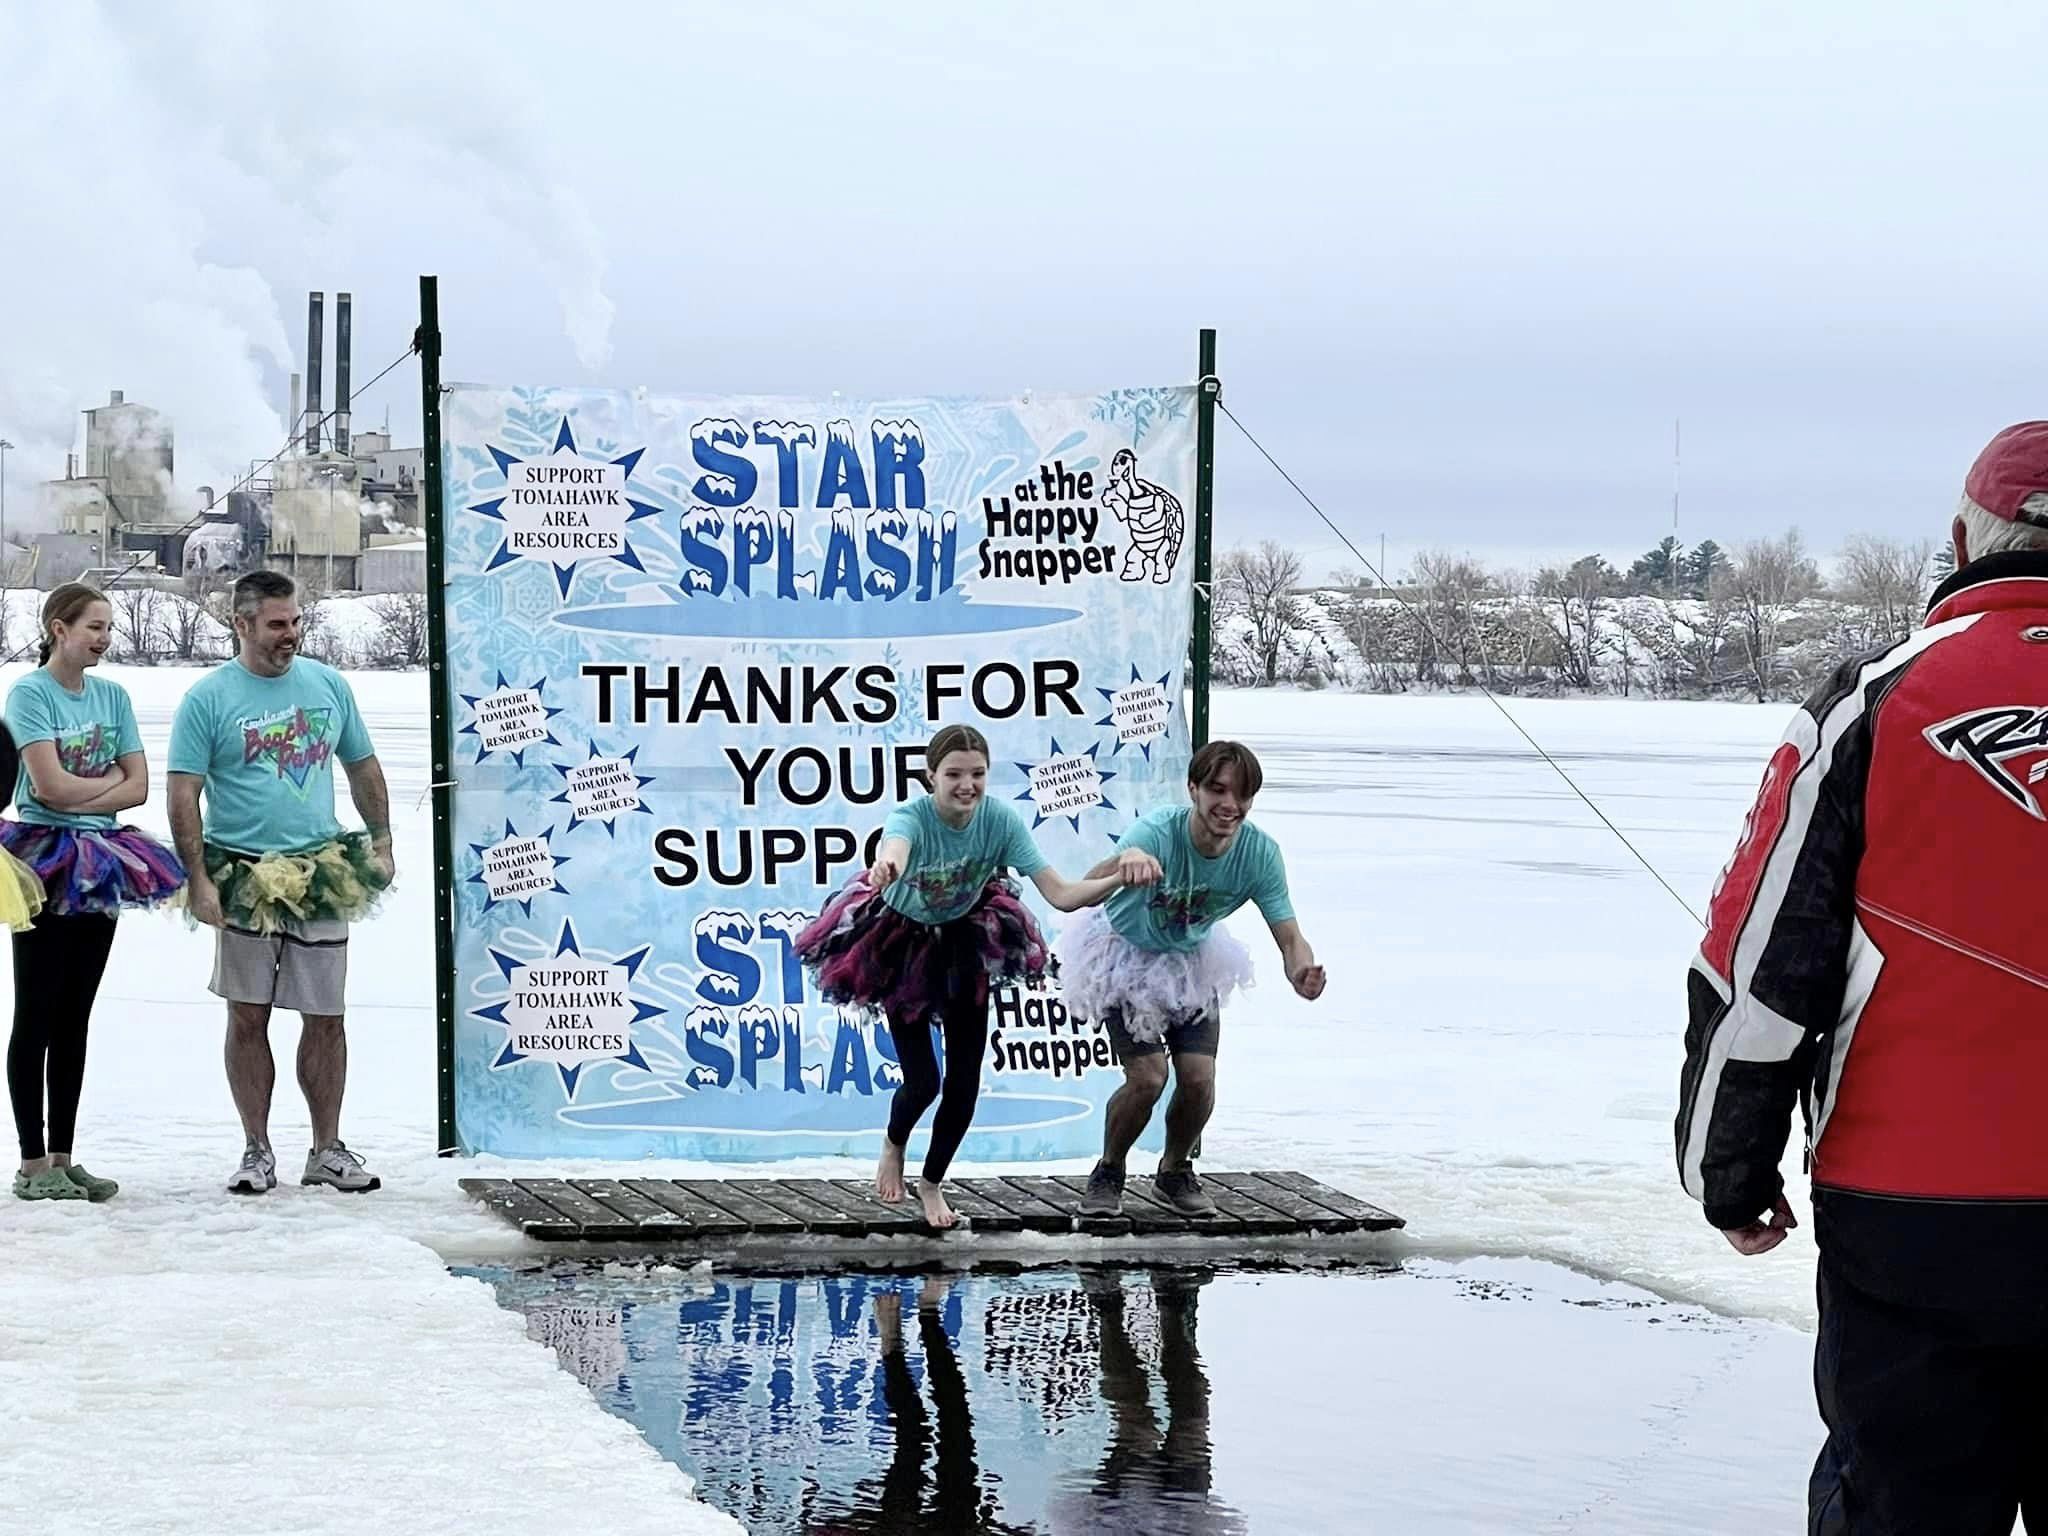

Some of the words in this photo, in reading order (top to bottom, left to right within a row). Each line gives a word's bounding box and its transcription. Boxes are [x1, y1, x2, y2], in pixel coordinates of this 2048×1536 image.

[689, 418, 926, 508] STAR
[526, 467, 605, 484] SUPPORT
[1015, 481, 1039, 502] at
[1040, 460, 1093, 501] the
[512, 489, 620, 506] TOMAHAWK
[541, 511, 589, 527] AREA
[982, 497, 1098, 544] Happy
[513, 532, 618, 549] RESOURCES
[679, 506, 957, 602] SPLASH
[979, 538, 1116, 586] Snapper
[484, 693, 529, 710] SUPPORT
[582, 665, 897, 725] THANKS
[926, 659, 1085, 721] FOR
[1120, 687, 1156, 703] SUPPORT
[480, 703, 540, 724] TOMAHAWK
[1116, 697, 1165, 716] TOMAHAWK
[499, 718, 526, 733] AREA
[1132, 712, 1154, 725] AREA
[486, 727, 545, 748] RESOURCES
[1120, 721, 1166, 739] RESOURCES
[576, 762, 621, 779] SUPPORT
[724, 745, 934, 806] YOUR
[1038, 758, 1083, 778] SUPPORT
[571, 772, 631, 793] TOMAHAWK
[1034, 768, 1094, 791] TOMAHAWK
[590, 788, 617, 802] AREA
[1053, 784, 1081, 799] AREA
[577, 796, 636, 818] RESOURCES
[1041, 791, 1099, 815] RESOURCES
[492, 841, 537, 859] SUPPORT
[654, 827, 885, 886] SUPP
[487, 852, 549, 873] TOMAHAWK
[507, 867, 535, 882] AREA
[493, 876, 552, 898] RESOURCES
[694, 911, 818, 1006] ST
[528, 970, 609, 987] SUPPORT
[515, 992, 623, 1009] TOMAHAWK
[545, 1013, 593, 1029] AREA
[518, 1034, 623, 1051] RESOURCES
[685, 1004, 946, 1095] SPLAS
